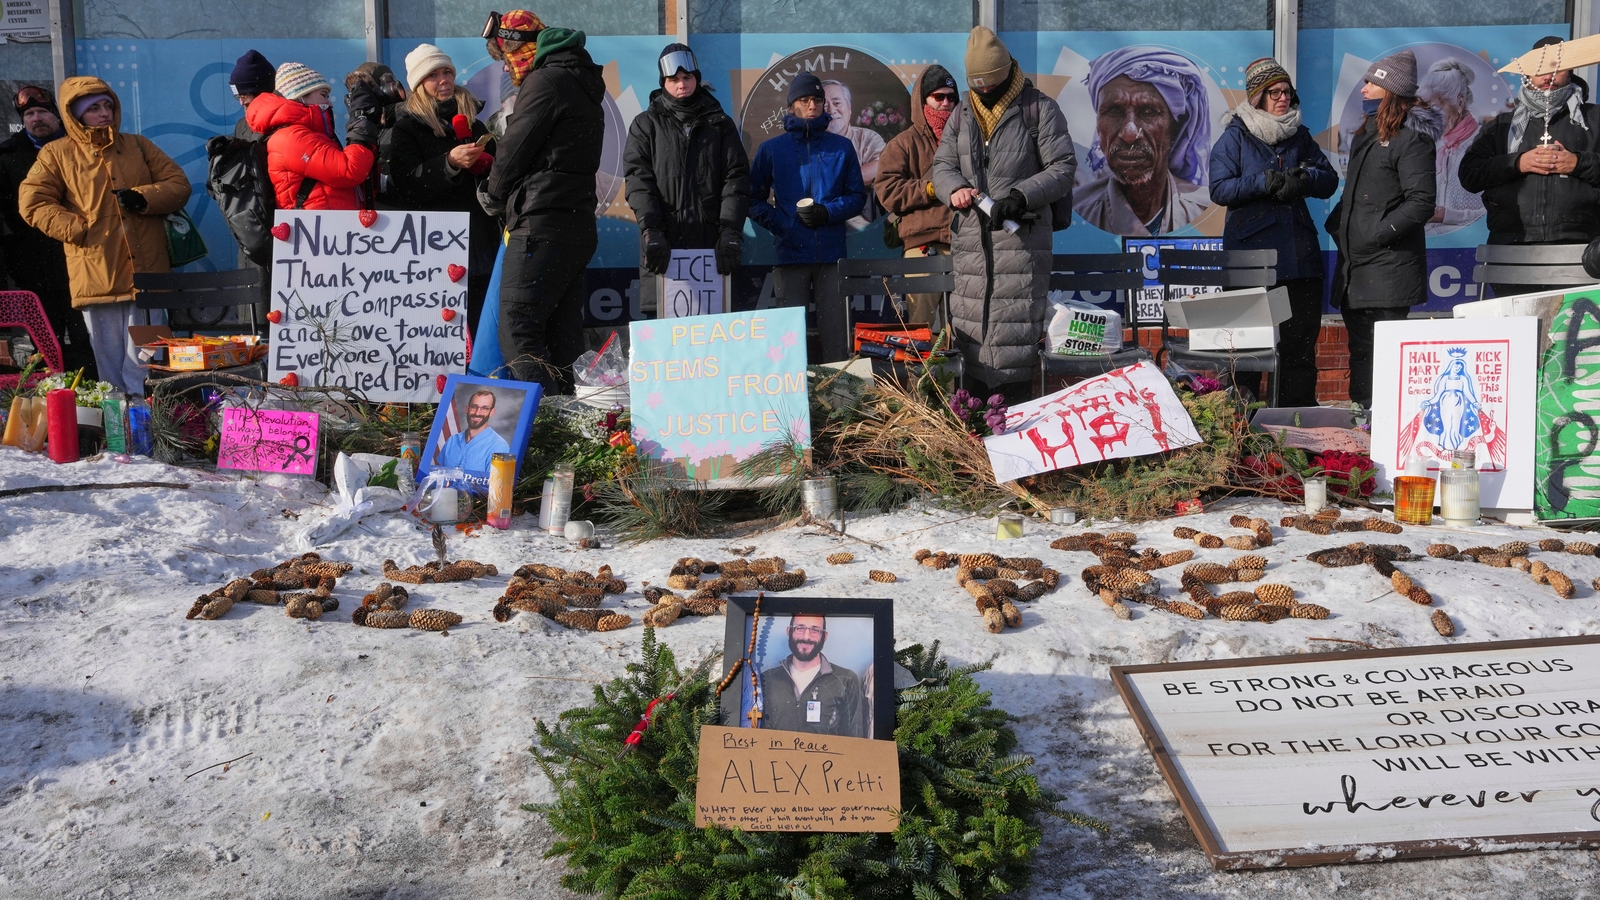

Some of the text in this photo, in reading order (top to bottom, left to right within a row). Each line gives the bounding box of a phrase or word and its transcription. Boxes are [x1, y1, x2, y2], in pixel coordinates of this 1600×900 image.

[498, 29, 513, 38] SPY
[293, 215, 391, 256] Nurse
[276, 259, 442, 293] Thank you for
[672, 255, 714, 283] ICE
[277, 289, 468, 322] Your Compassion
[673, 289, 716, 318] OUT
[1137, 289, 1164, 301] THEY
[278, 322, 323, 342] and
[333, 320, 392, 343] Love
[672, 318, 766, 346] PEACE
[1069, 320, 1105, 337] HOME
[276, 343, 465, 373] Everyone You have
[632, 356, 720, 382] STEMS
[1409, 351, 1501, 363] HAIL KICK
[314, 362, 430, 392] Cared For
[1409, 365, 1440, 376] MARY
[727, 372, 805, 397] FROM
[1407, 386, 1431, 395] Grace
[1479, 383, 1499, 392] This
[1481, 393, 1502, 403] Place
[228, 409, 251, 422] The
[659, 410, 779, 437] JUSTICE
[225, 434, 235, 442] to
[227, 423, 261, 435] always
[1163, 658, 1574, 696] BE STRONG & COURAGEOUS
[1236, 682, 1525, 713] DO NOT BE AFRAID
[1387, 700, 1600, 726] OR DISCOURA
[723, 733, 829, 751] Rest in Peace
[1207, 741, 1271, 757] FOR
[1281, 737, 1351, 754] THE
[1360, 732, 1447, 751] LORD
[1451, 726, 1550, 744] YOUR
[1372, 746, 1600, 773] WILL BE WITH
[721, 759, 884, 795] ALEX Pretti
[1303, 774, 1542, 815] wherever
[700, 805, 735, 814] WHAT
[818, 806, 837, 815] your
[841, 805, 891, 814] government
